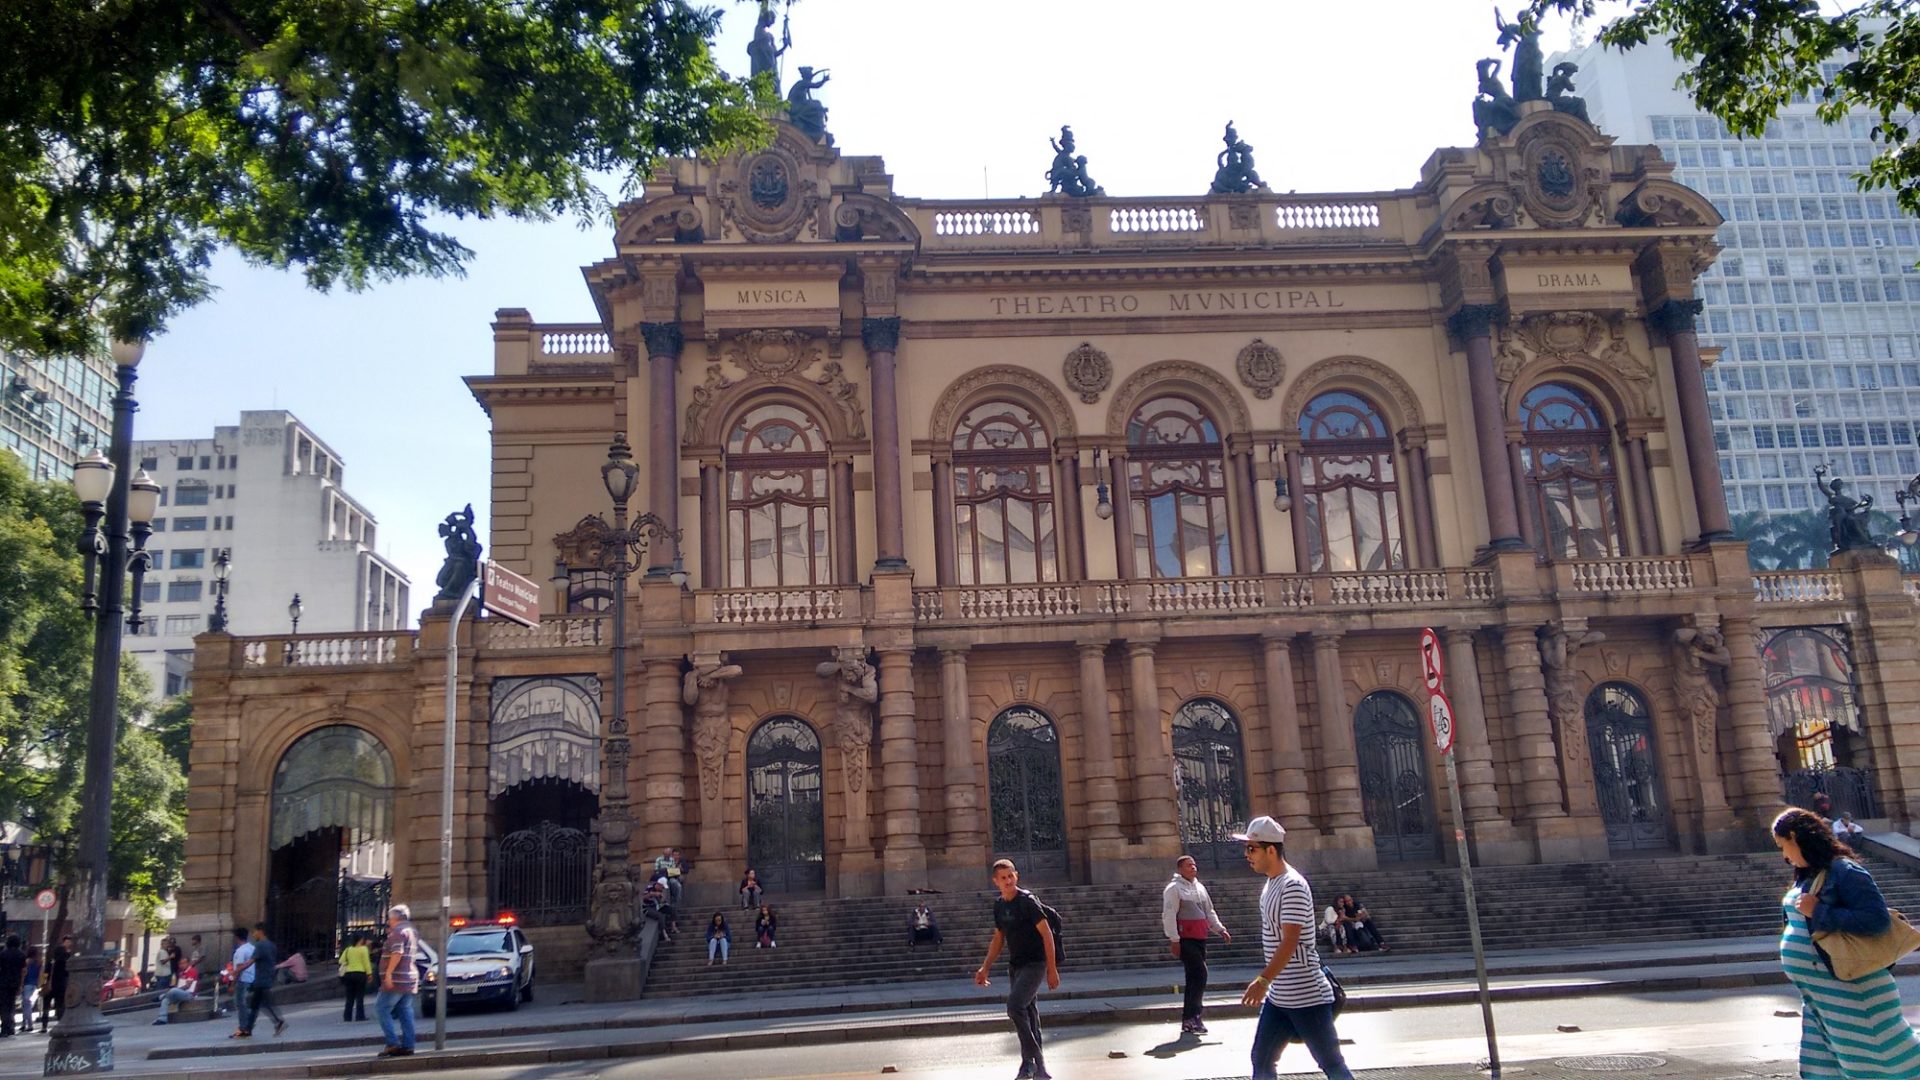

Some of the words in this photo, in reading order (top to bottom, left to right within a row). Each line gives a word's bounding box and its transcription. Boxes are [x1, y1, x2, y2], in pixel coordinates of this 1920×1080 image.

[1537, 273, 1602, 288] DRAMA
[737, 289, 808, 304] MVSICA
[990, 295, 1139, 315] THEATRO
[1169, 290, 1345, 311] MVNICIPAL
[496, 574, 514, 593] Teatro
[514, 583, 538, 604] Municipal
